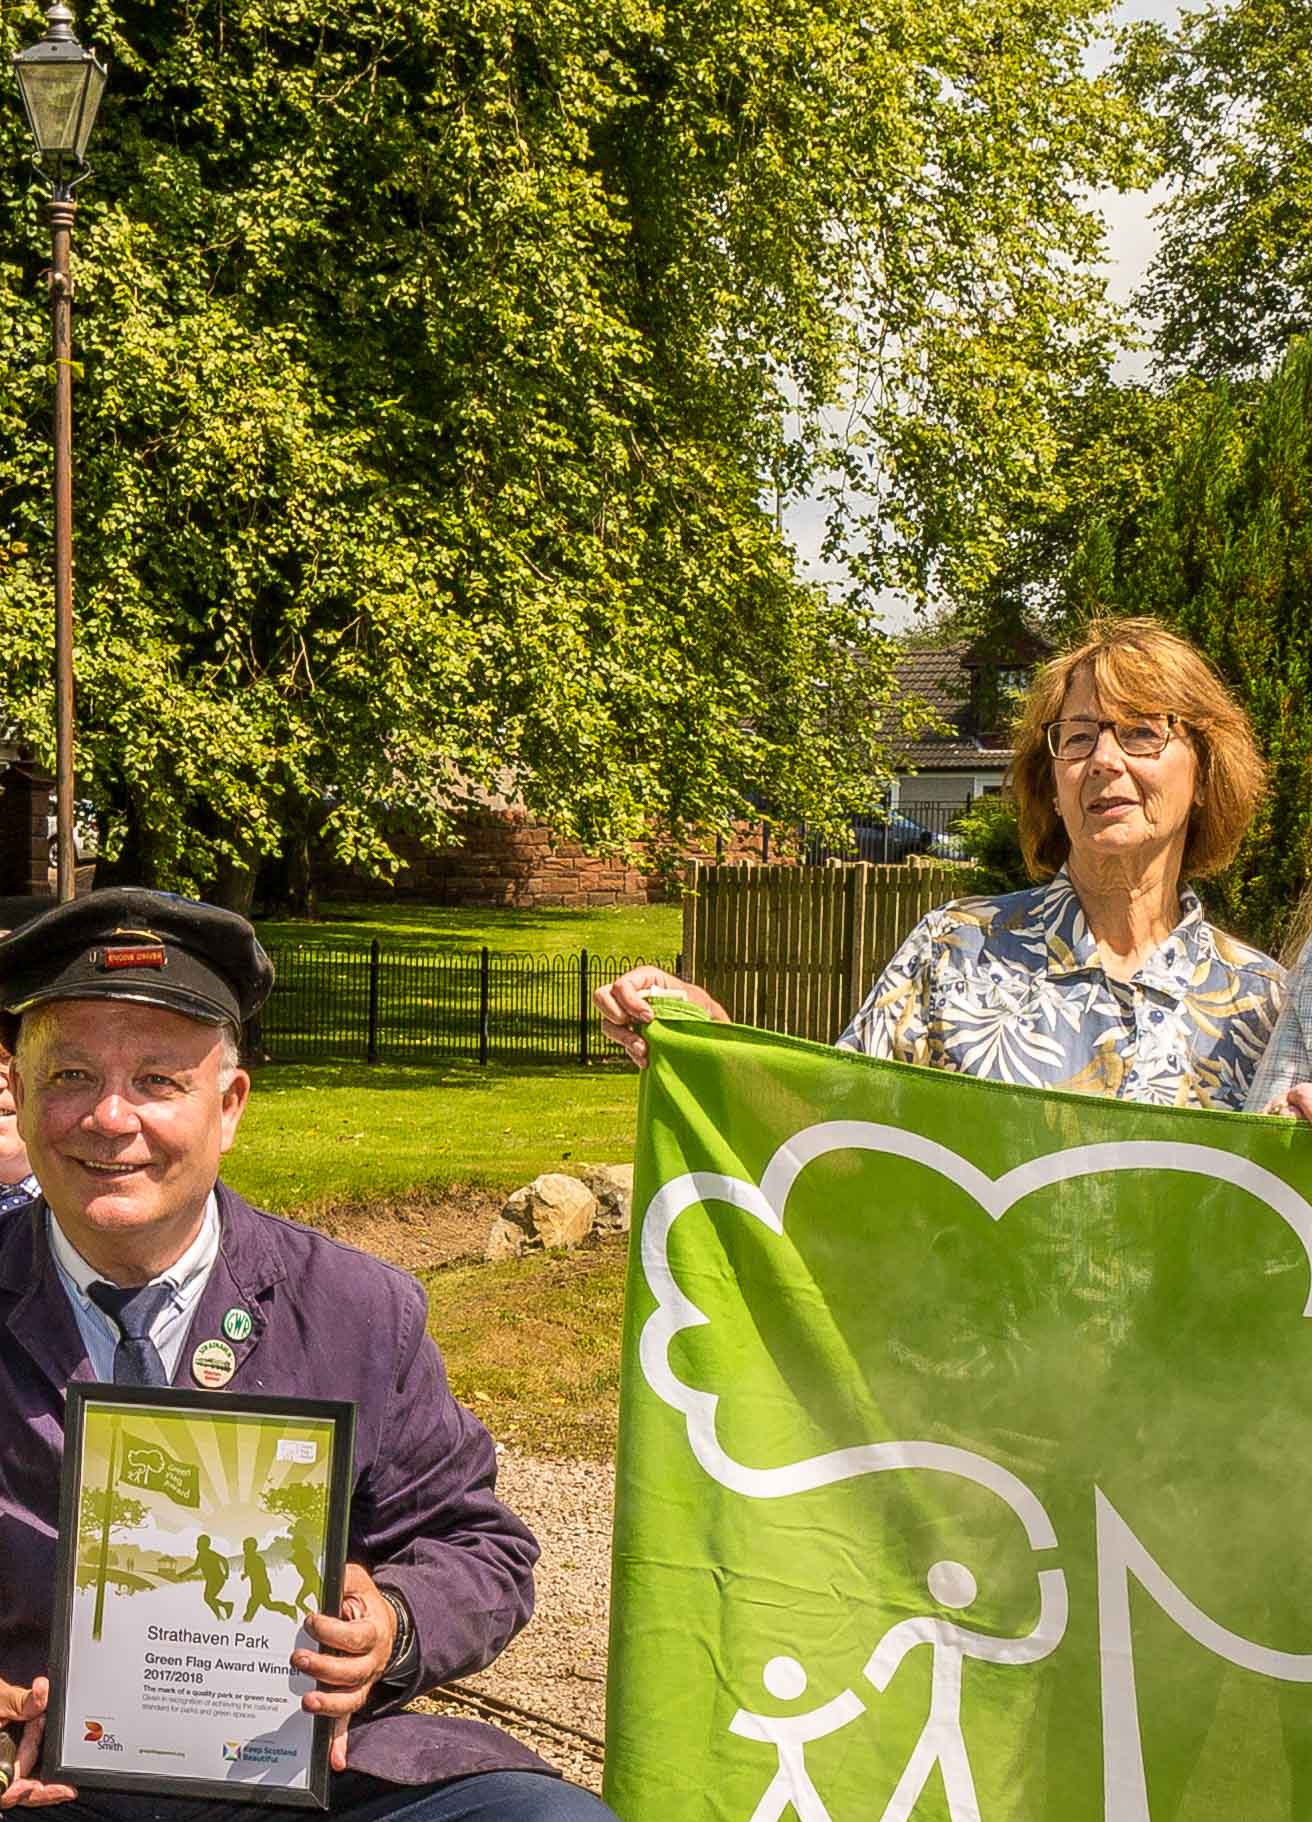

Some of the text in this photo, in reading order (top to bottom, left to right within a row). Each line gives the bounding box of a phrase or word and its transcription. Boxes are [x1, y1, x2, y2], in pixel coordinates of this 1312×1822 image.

[147, 1625, 269, 1649] Strathaven Park
[144, 1652, 183, 1666] Green
[186, 1655, 212, 1671] Flag
[214, 1658, 255, 1672] Award
[143, 1668, 204, 1684] 2017/2018
[192, 1689, 216, 1699] quality
[217, 1691, 233, 1700] park
[244, 1694, 265, 1702] green
[97, 1741, 124, 1752] Smith
